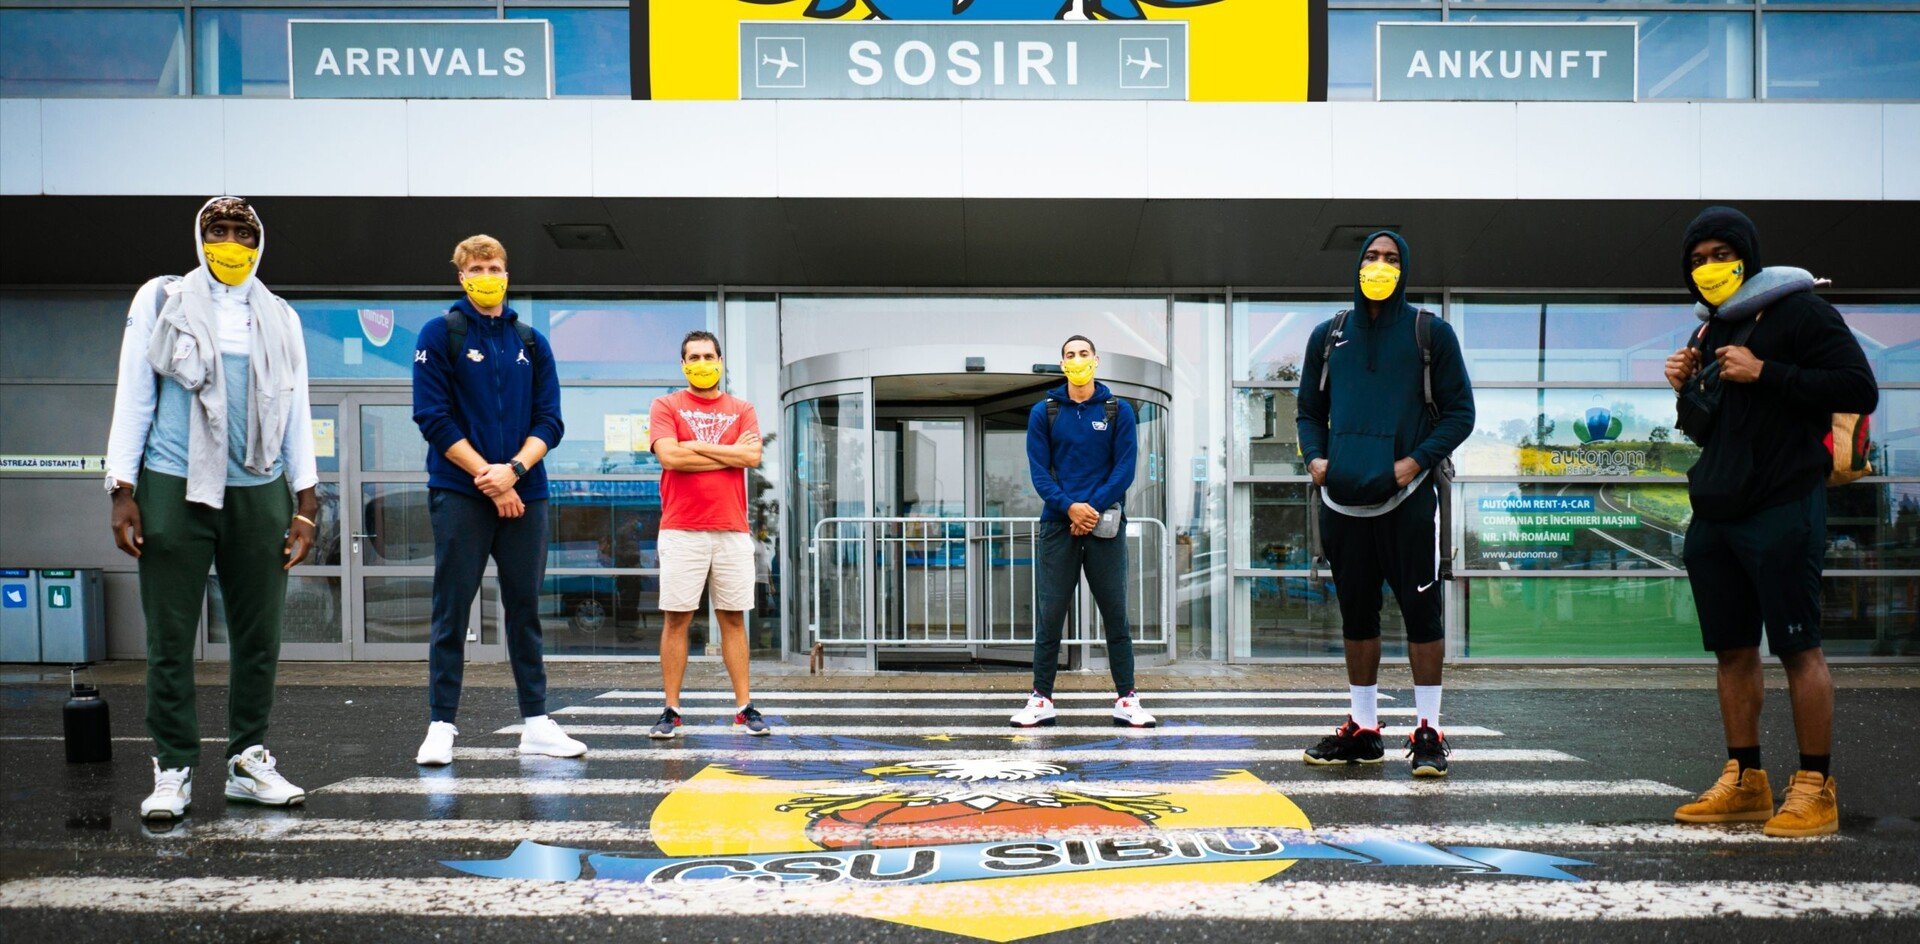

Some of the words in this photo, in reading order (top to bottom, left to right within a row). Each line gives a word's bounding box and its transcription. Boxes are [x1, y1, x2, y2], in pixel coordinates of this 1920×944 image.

[314, 47, 526, 76] ARRIVALS
[848, 40, 1077, 86] SOSIRI
[1407, 50, 1608, 79] ANKUNFT
[1551, 448, 1645, 465] autonom
[1482, 500, 1532, 509] AUTONOM
[1534, 500, 1590, 509] RENT-A-CAR
[1483, 516, 1533, 525] COMPANIA
[1536, 516, 1548, 525] DE
[1550, 514, 1600, 525] ÎNCHIRIERI
[1602, 516, 1637, 527] MAȘINI
[1483, 532, 1499, 541] NR.
[1502, 532, 1506, 541] 1
[1509, 530, 1520, 541] ÎN
[1521, 530, 1570, 541] ROMÂNIA!
[1482, 550, 1558, 559] www.autonom.ro
[646, 849, 941, 892] CSU
[979, 830, 1285, 872] SIBIU
